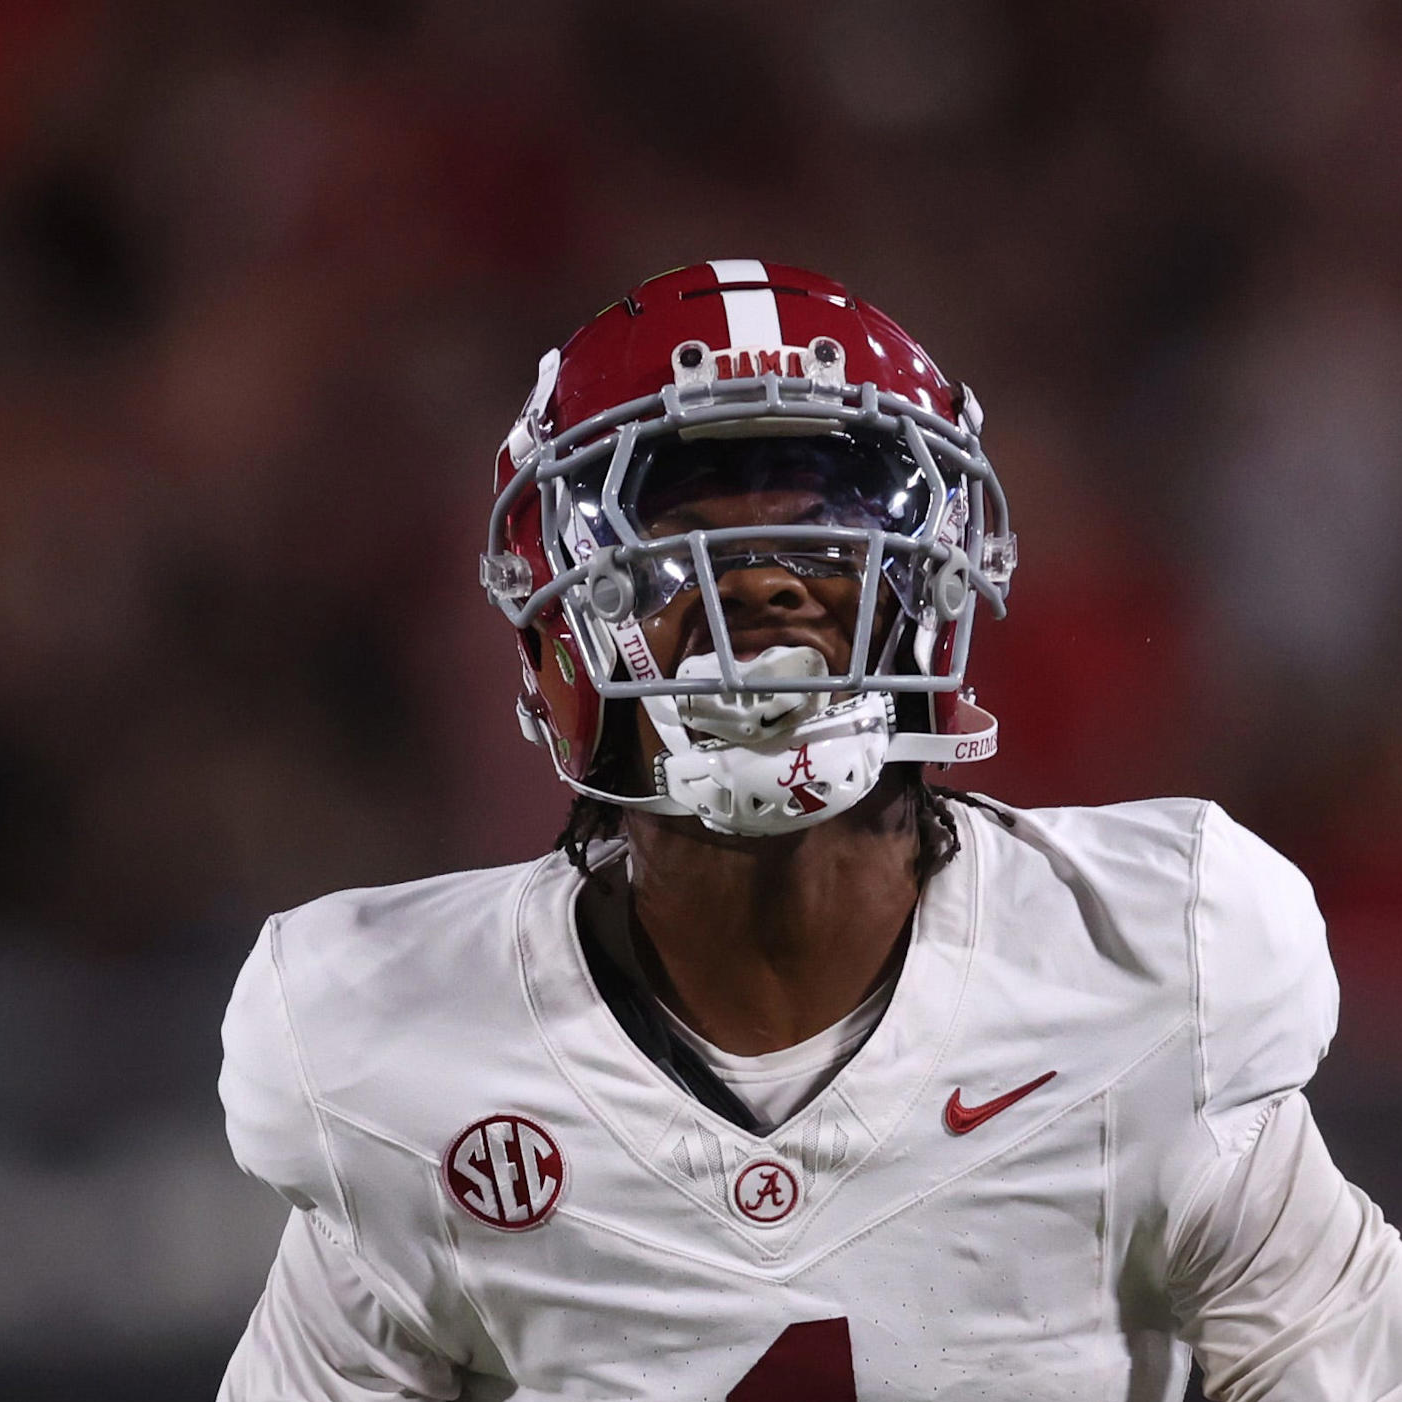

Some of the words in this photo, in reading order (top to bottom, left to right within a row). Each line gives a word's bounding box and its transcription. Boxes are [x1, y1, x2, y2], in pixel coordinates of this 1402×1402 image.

[716, 350, 805, 380] BAMA
[777, 743, 816, 787] A
[453, 1121, 557, 1223] SEC
